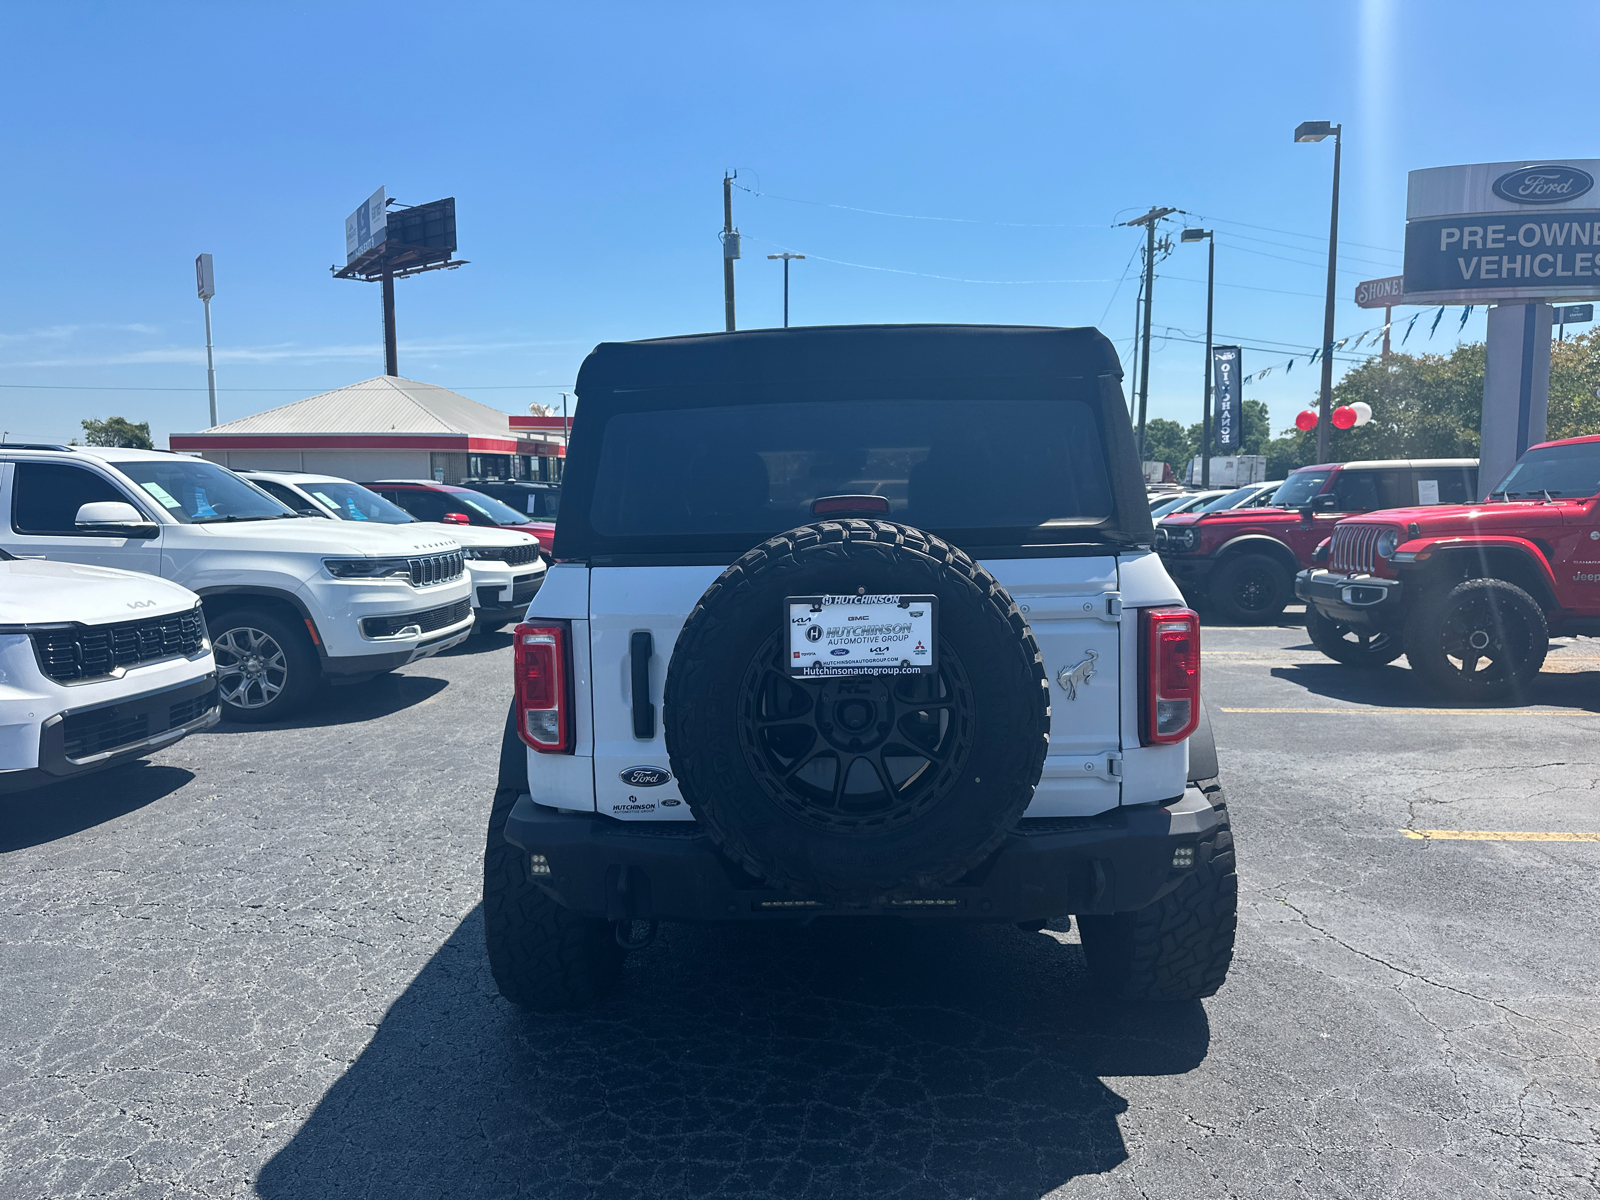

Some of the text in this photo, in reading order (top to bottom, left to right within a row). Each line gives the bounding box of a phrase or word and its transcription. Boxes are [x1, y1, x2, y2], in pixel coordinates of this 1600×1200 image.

[1519, 174, 1574, 194] Ford
[1572, 571, 1600, 582] Jeep
[126, 600, 156, 609] KIA
[834, 594, 900, 606] HUTCHINSON
[826, 623, 912, 638] HUTCHINSON
[828, 635, 909, 646] AUTOMOTIVE GROUP
[823, 657, 899, 665] HUTCHINSONAUTOGROUP.COM
[803, 667, 920, 676] Hutchinsonautogroup.com
[838, 680, 872, 694] RC
[631, 770, 658, 782] Ford
